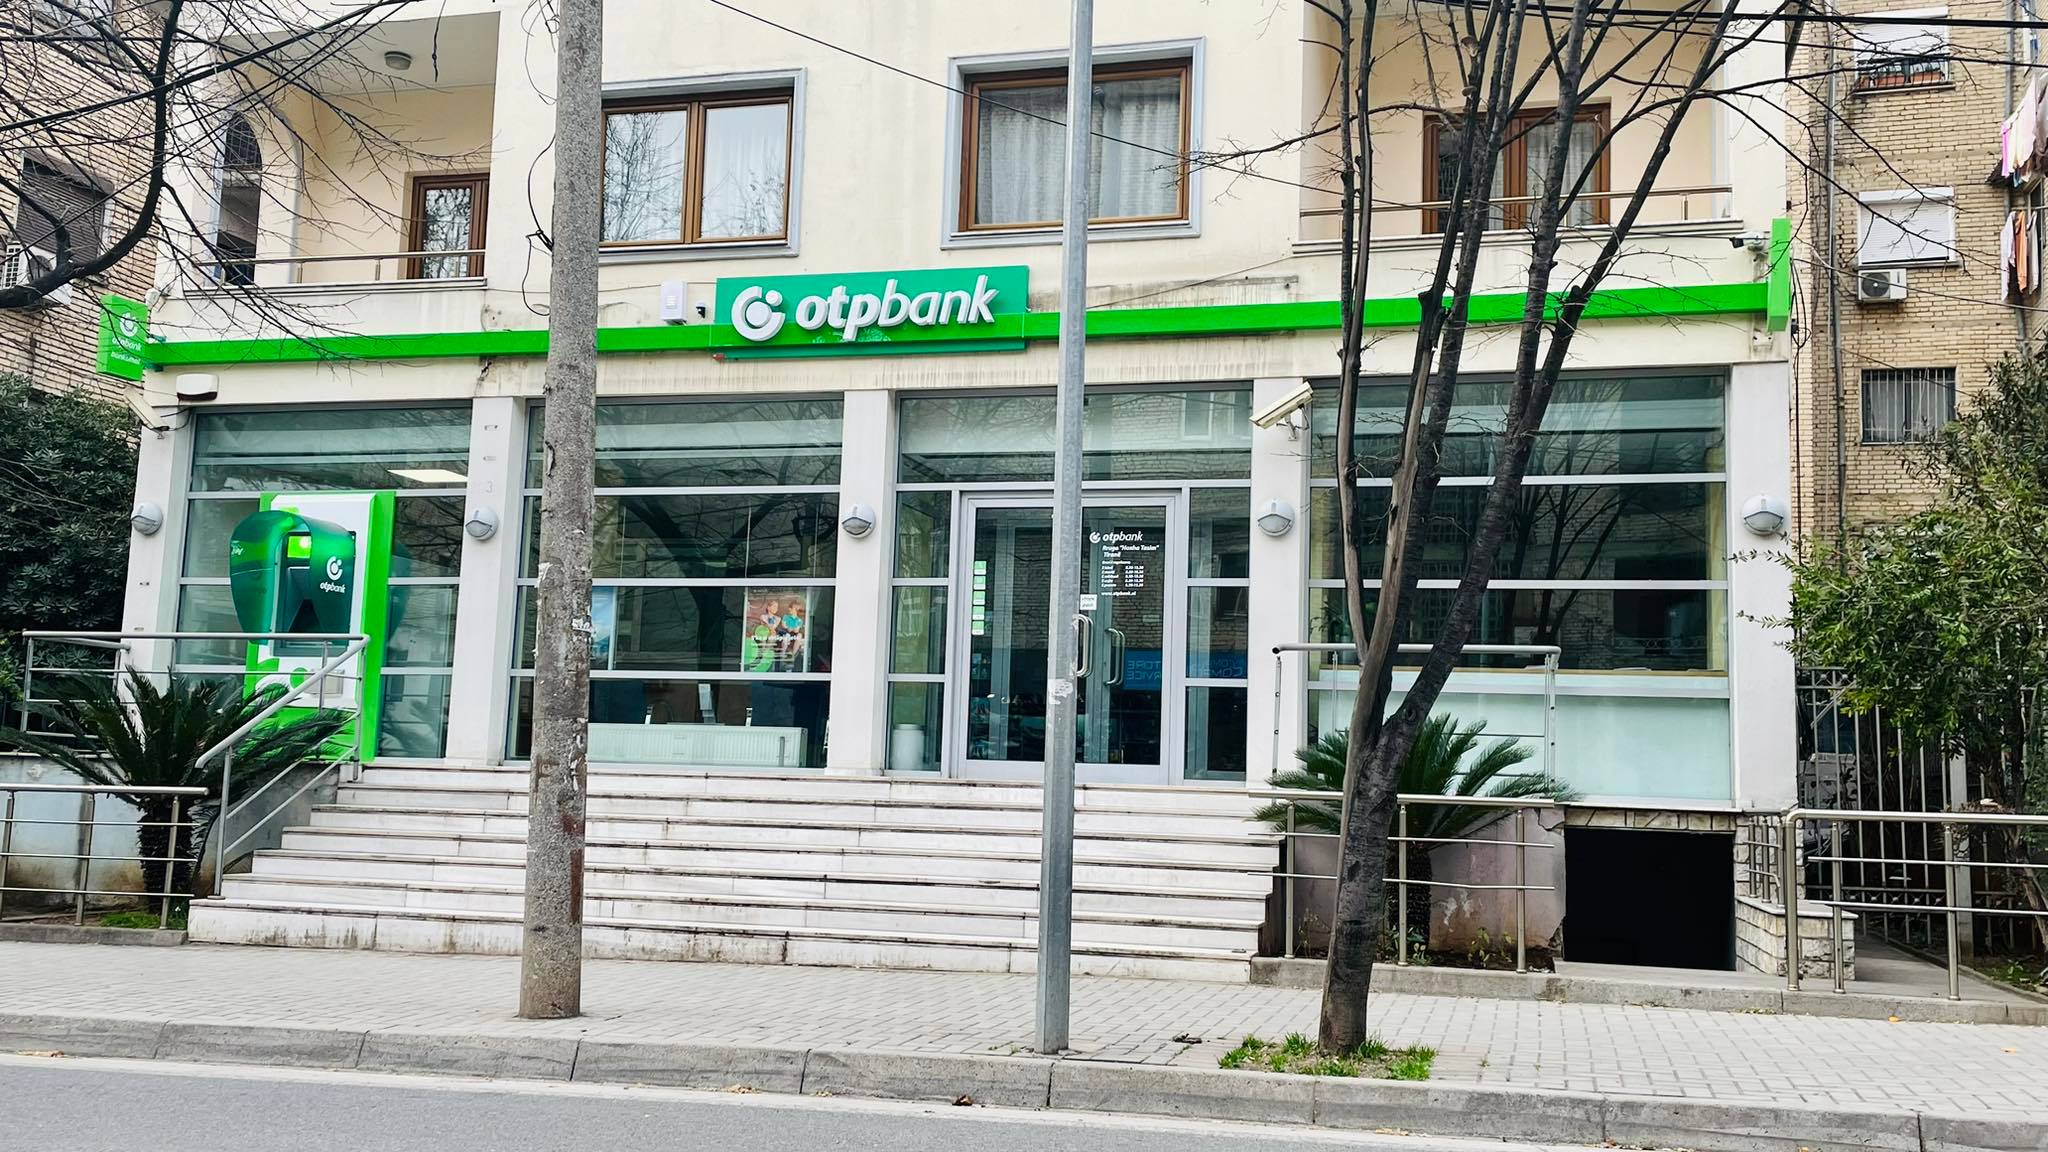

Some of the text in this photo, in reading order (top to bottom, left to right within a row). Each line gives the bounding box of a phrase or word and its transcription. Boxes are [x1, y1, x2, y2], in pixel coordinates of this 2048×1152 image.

[795, 274, 999, 342] otpbank
[1102, 531, 1144, 544] otpbank
[320, 582, 346, 593] otpbank
